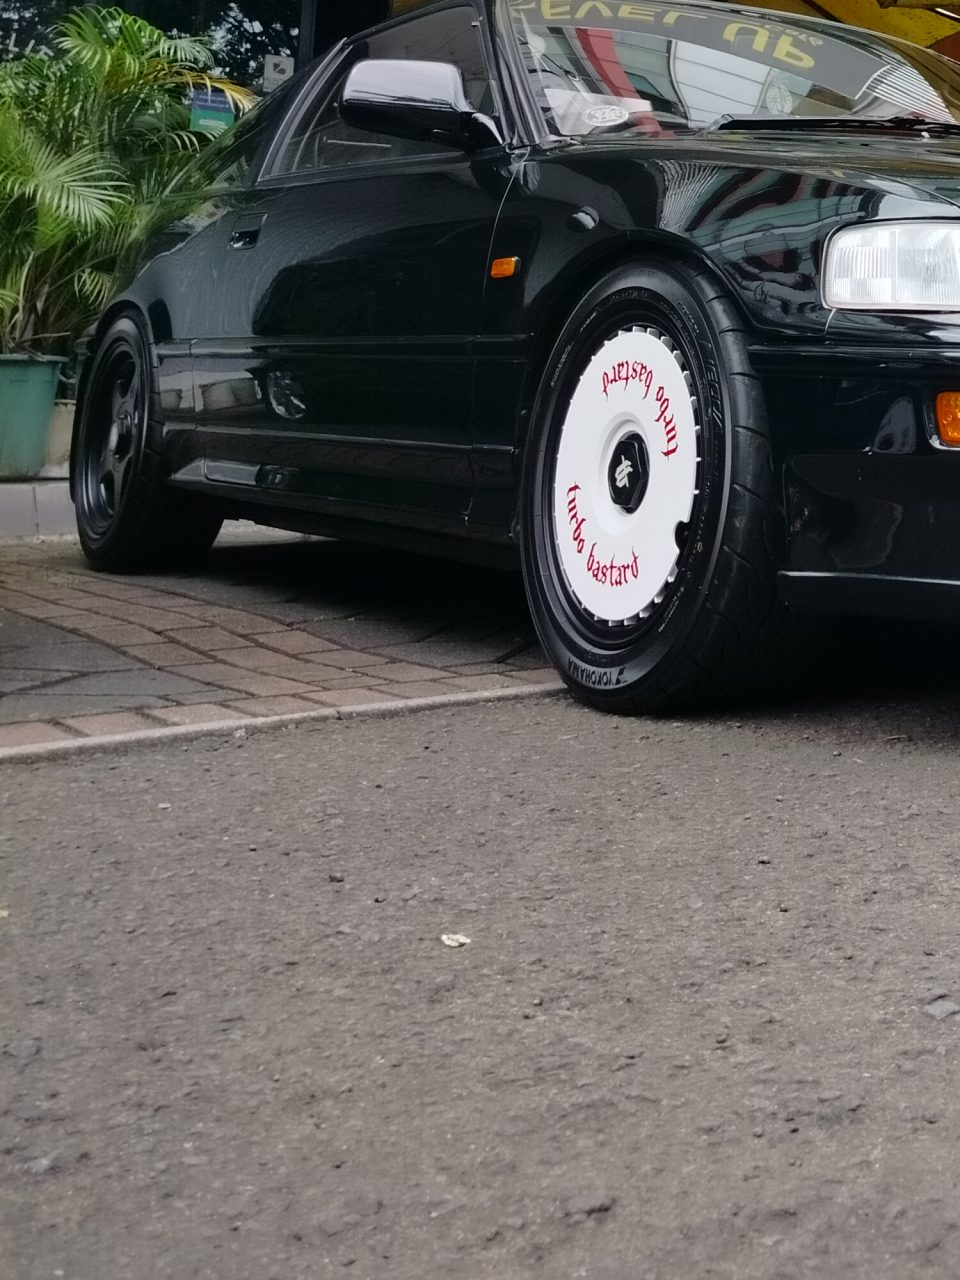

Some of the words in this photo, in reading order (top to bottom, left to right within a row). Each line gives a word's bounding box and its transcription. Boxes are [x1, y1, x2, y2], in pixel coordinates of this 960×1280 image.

[602, 360, 653, 401] bastard
[585, 544, 640, 588] bastard
[567, 657, 614, 687] YOKOHAMA
